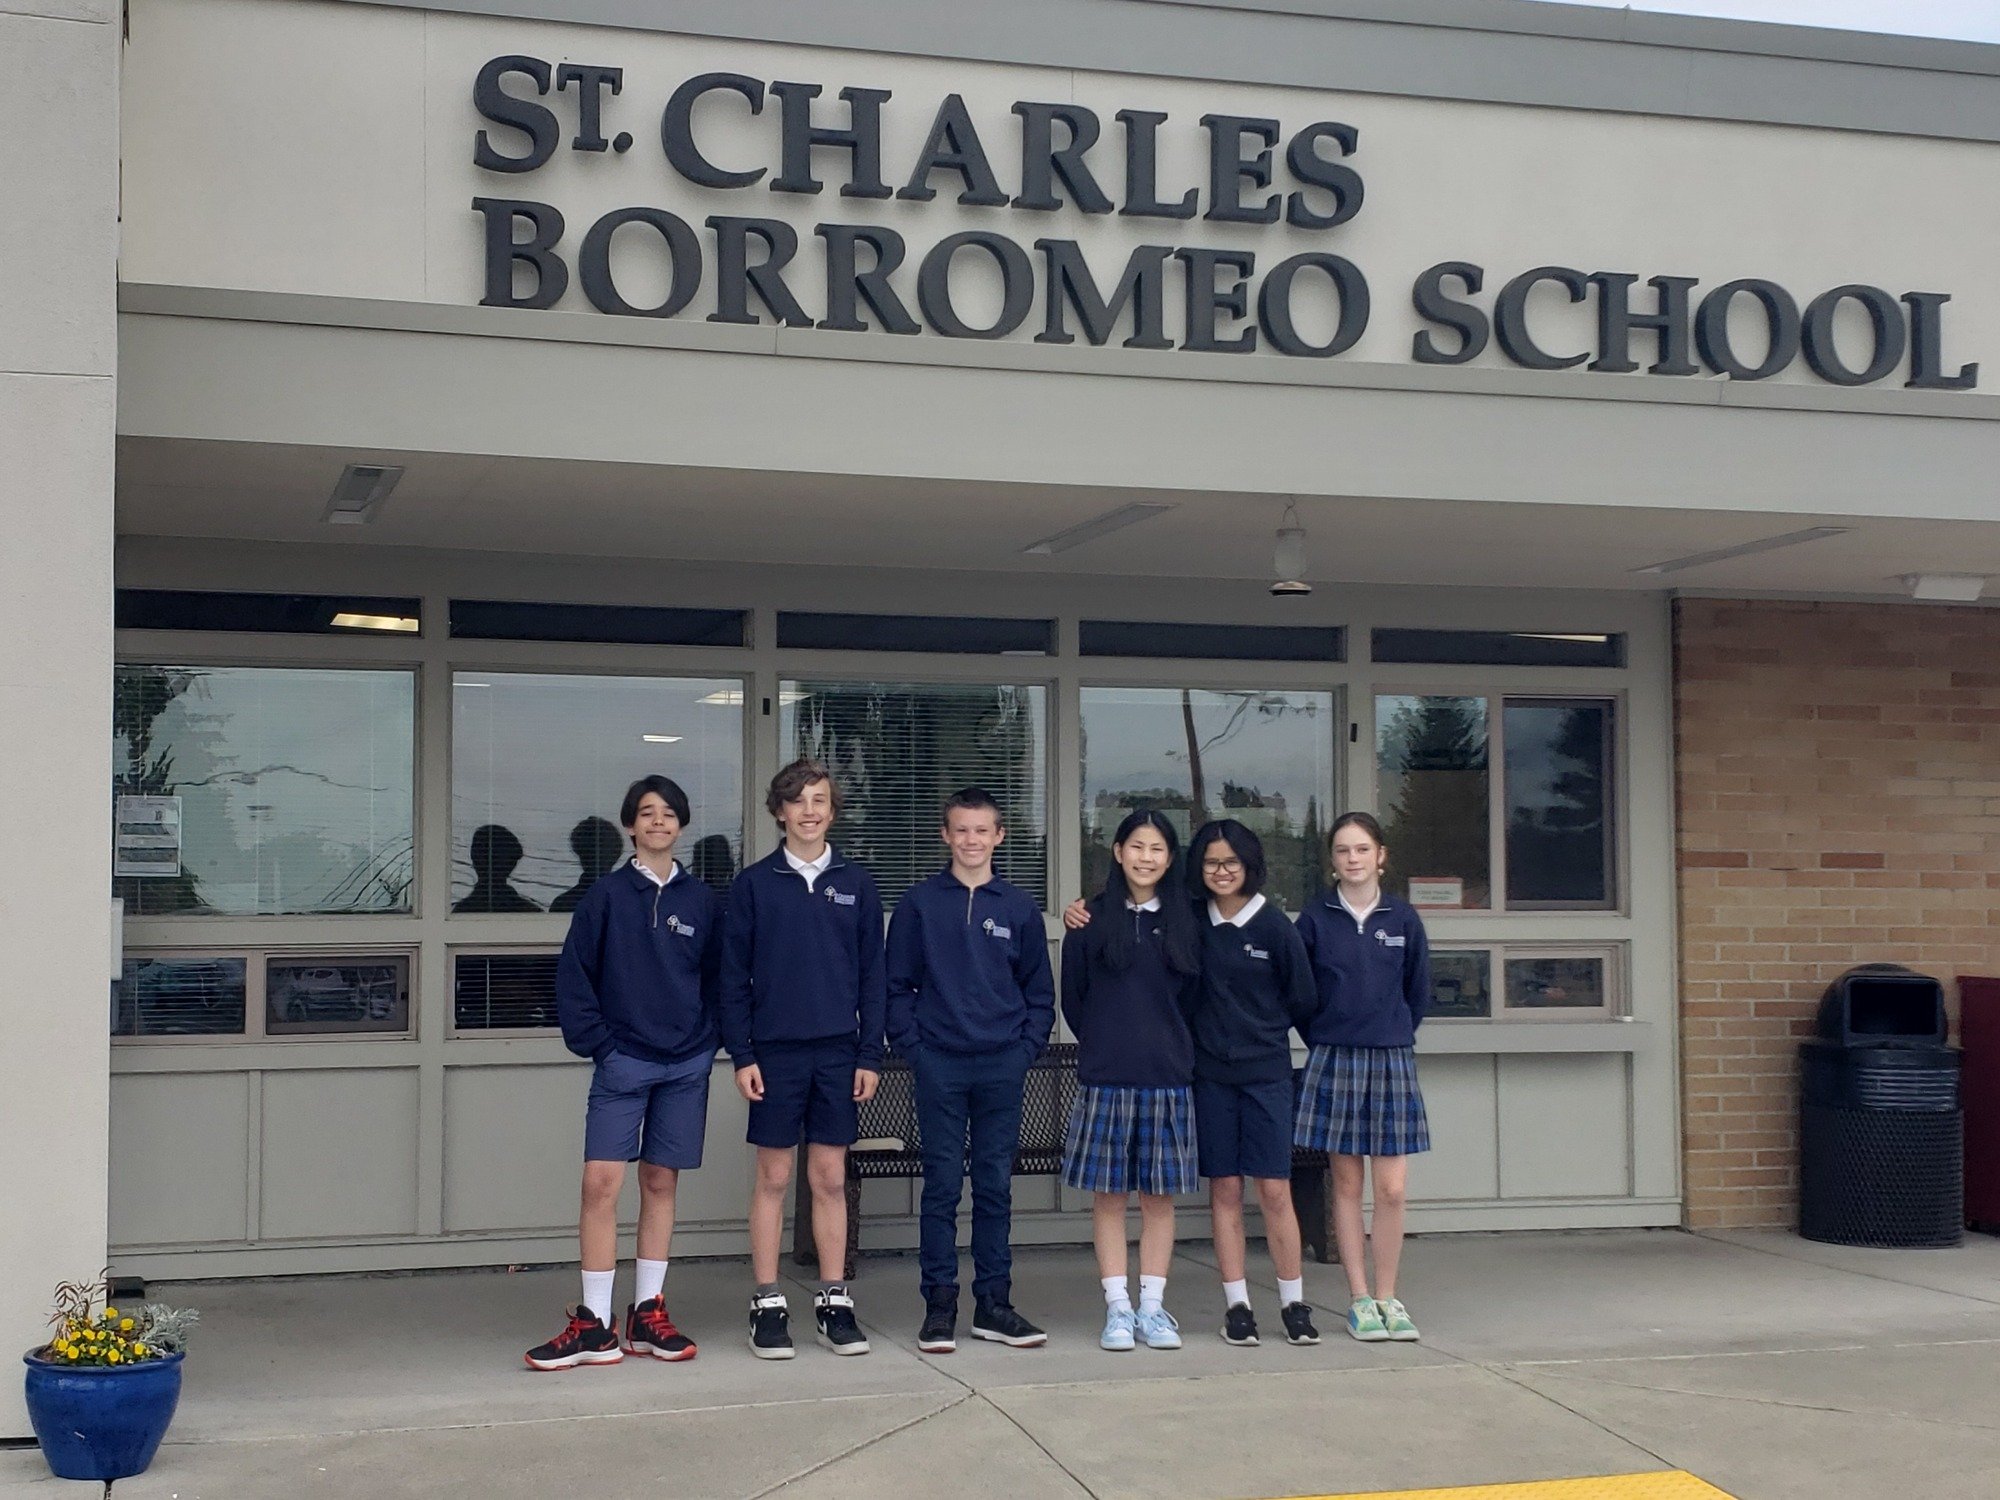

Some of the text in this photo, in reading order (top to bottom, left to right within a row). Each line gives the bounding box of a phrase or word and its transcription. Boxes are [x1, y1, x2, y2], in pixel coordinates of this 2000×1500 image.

[473, 55, 1364, 230] ST. CHARLES
[471, 197, 1978, 391] BORROMEO SCHOOL
